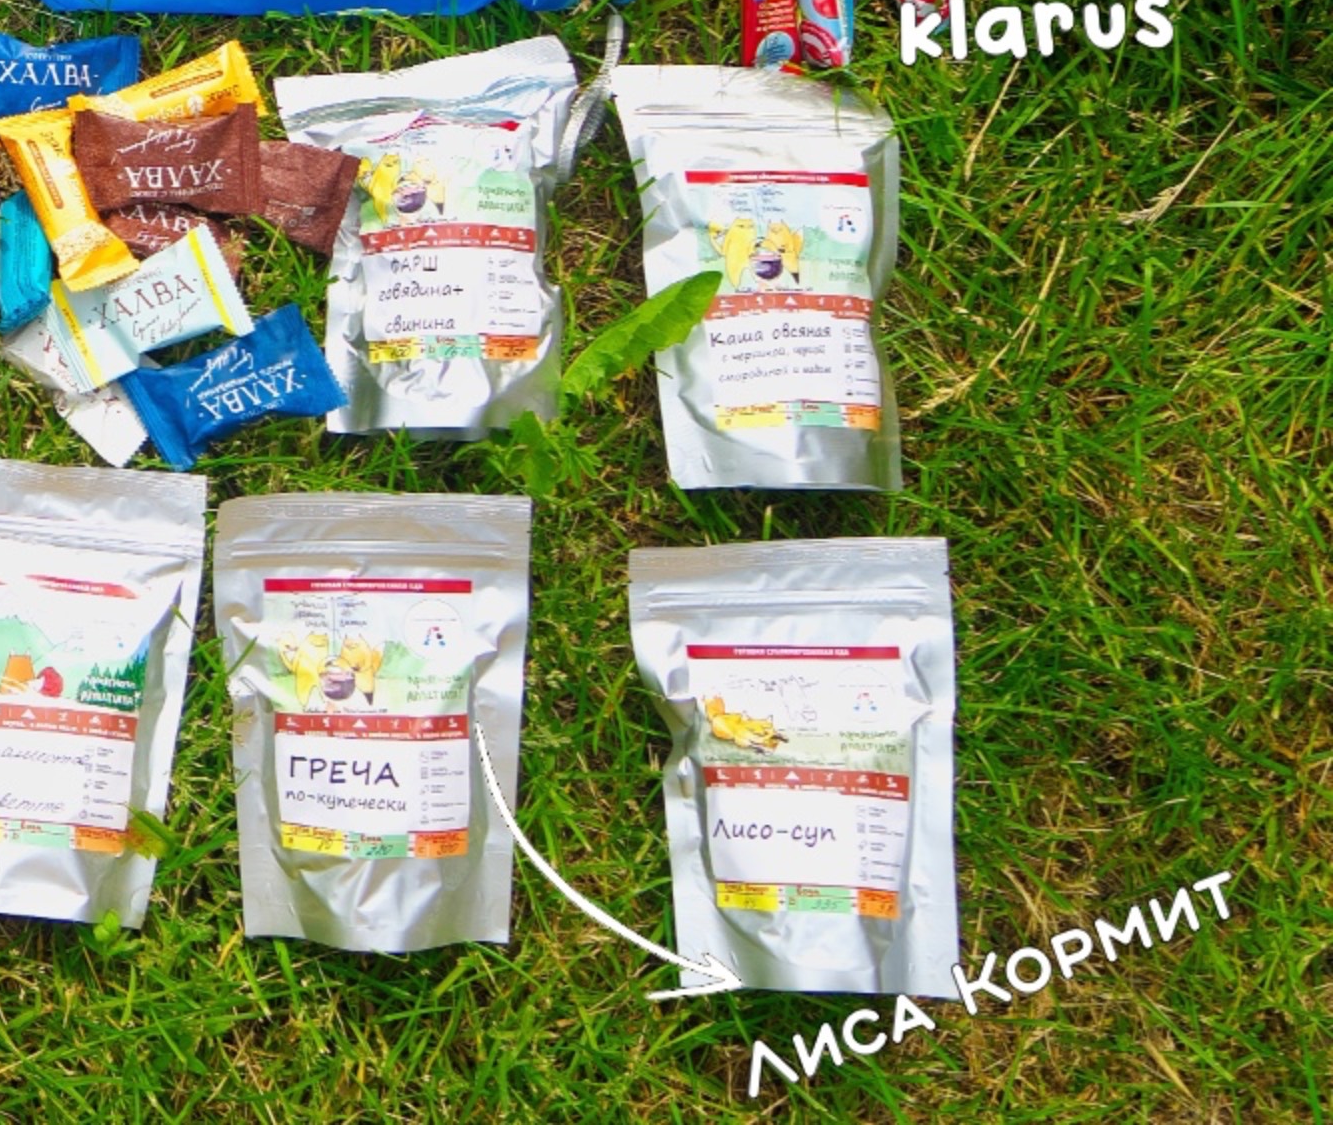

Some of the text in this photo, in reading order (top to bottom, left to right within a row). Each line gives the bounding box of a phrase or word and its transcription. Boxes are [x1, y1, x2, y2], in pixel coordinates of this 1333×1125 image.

[123, 158, 224, 189] ХАЛВА
[118, 203, 208, 233] АЛВ
[92, 274, 195, 330] ХАЛВА
[385, 315, 456, 335] свинина
[709, 323, 832, 347] Каша овсяная
[200, 366, 304, 420] ХАЛВА
[289, 755, 400, 787] ГРЕЧА
[285, 789, 407, 812] по-купечески
[713, 818, 837, 848] Лисо-суп
